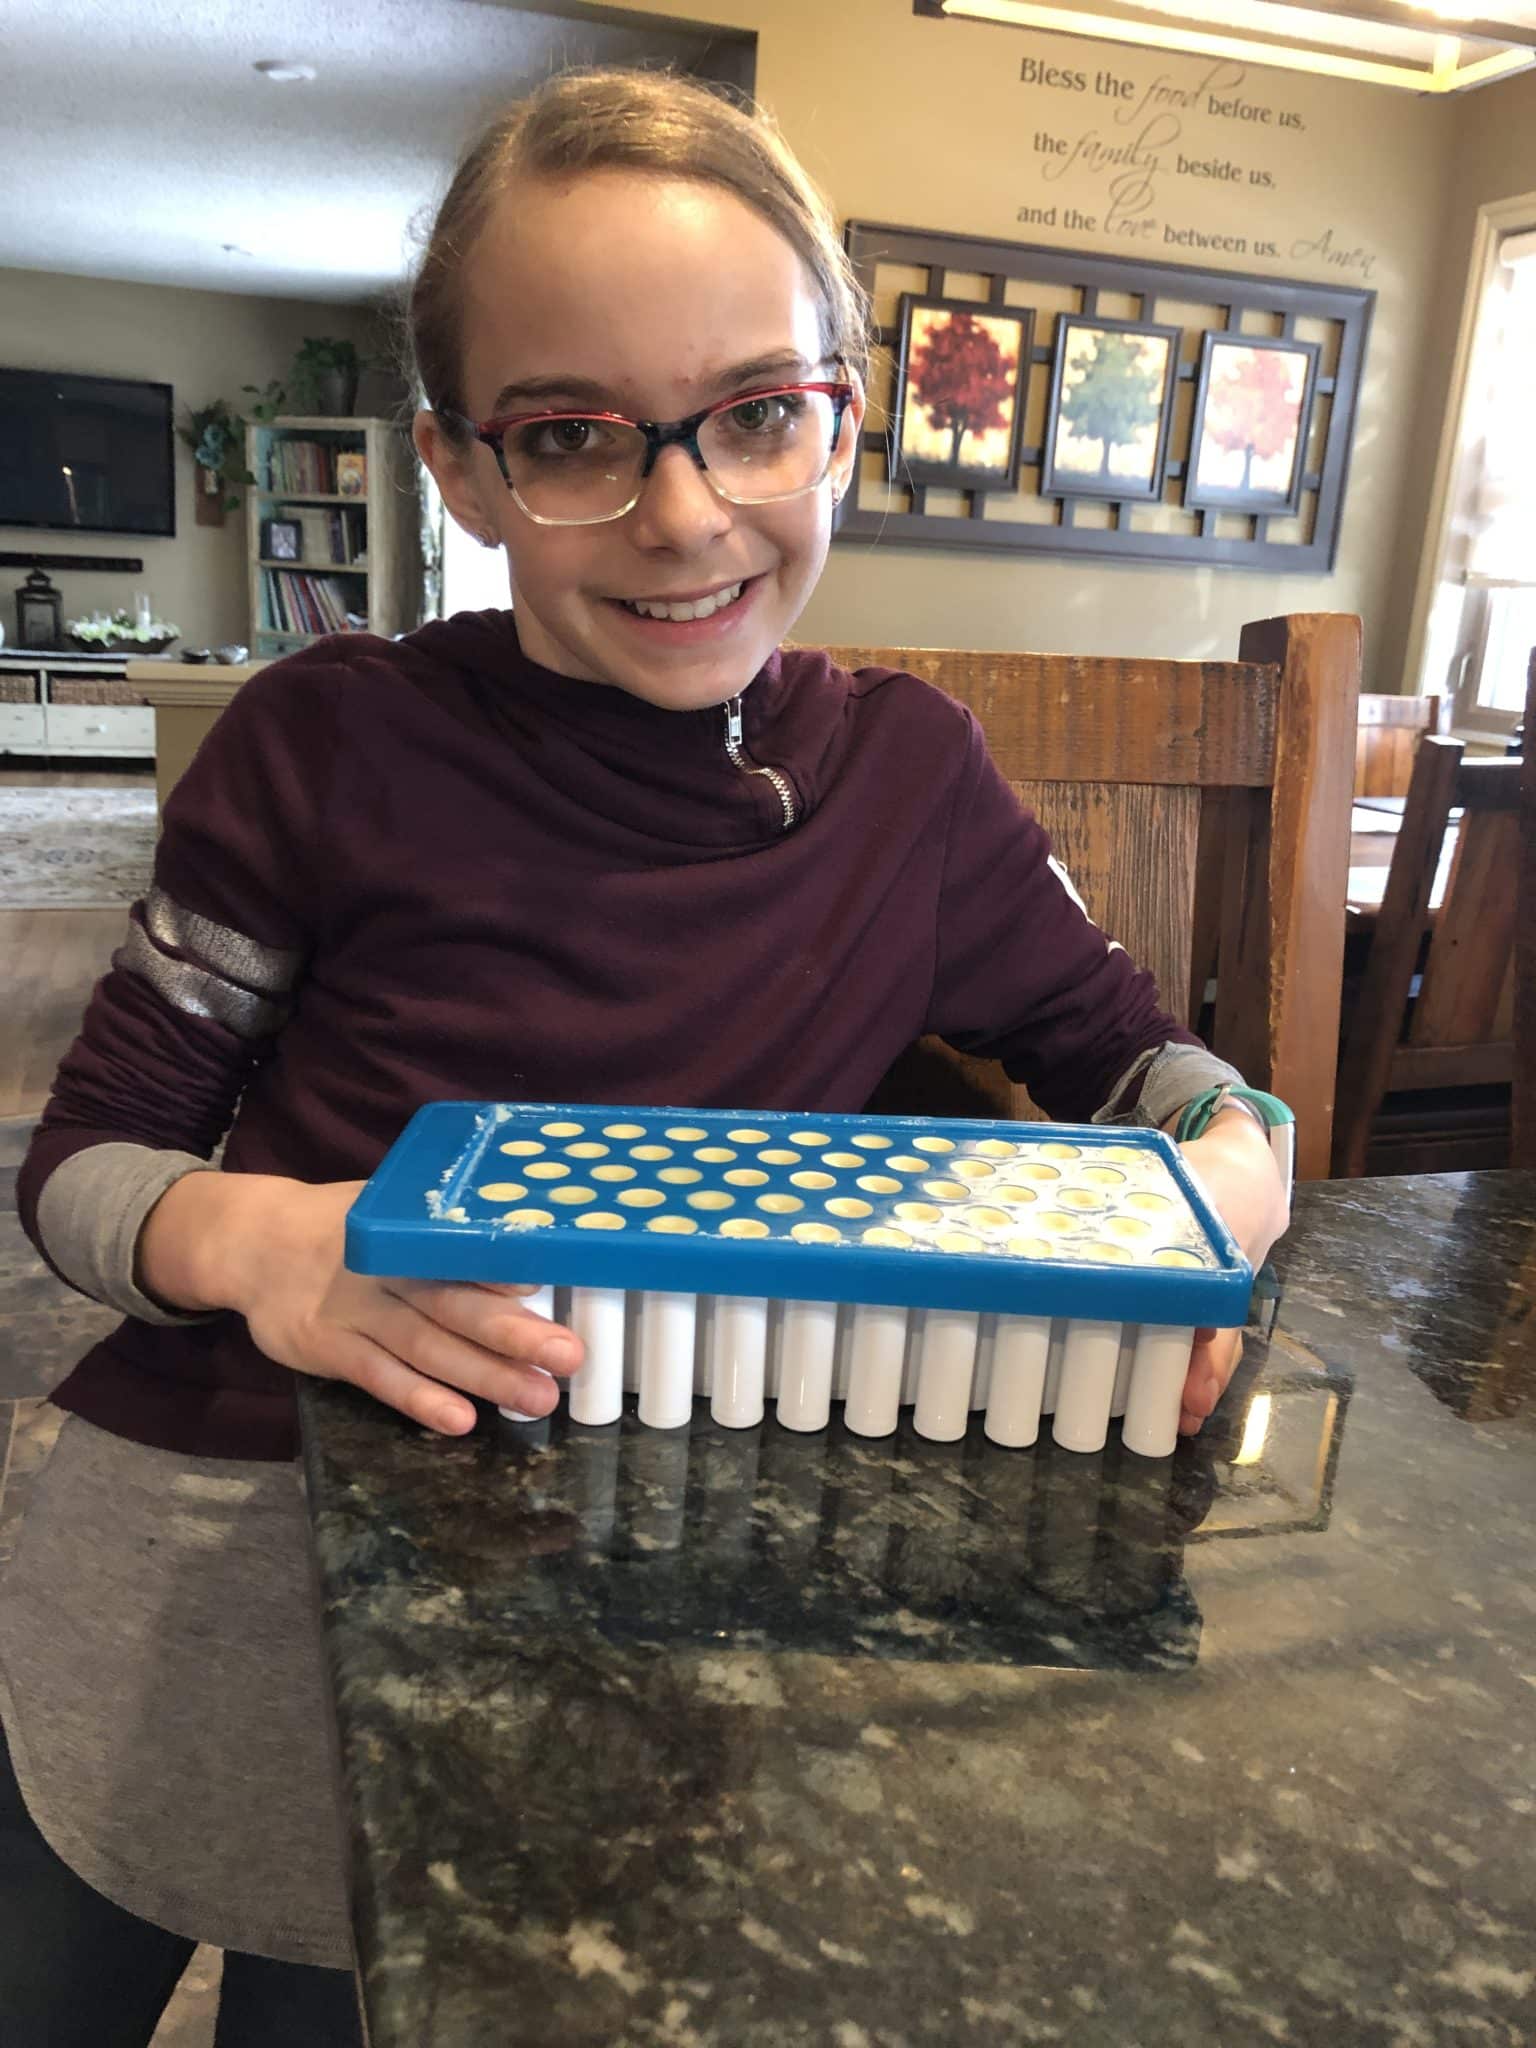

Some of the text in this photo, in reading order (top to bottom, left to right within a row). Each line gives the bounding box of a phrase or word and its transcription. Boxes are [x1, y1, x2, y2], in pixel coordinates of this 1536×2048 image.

[1019, 57, 1087, 92] Bless
[1095, 70, 1134, 99] the
[1114, 60, 1247, 125] food
[1207, 95, 1273, 124] before
[1033, 131, 1068, 155] the
[1042, 113, 1182, 206] family
[1176, 154, 1243, 182] beside
[1016, 180, 1377, 279] and the love between us. Amen
